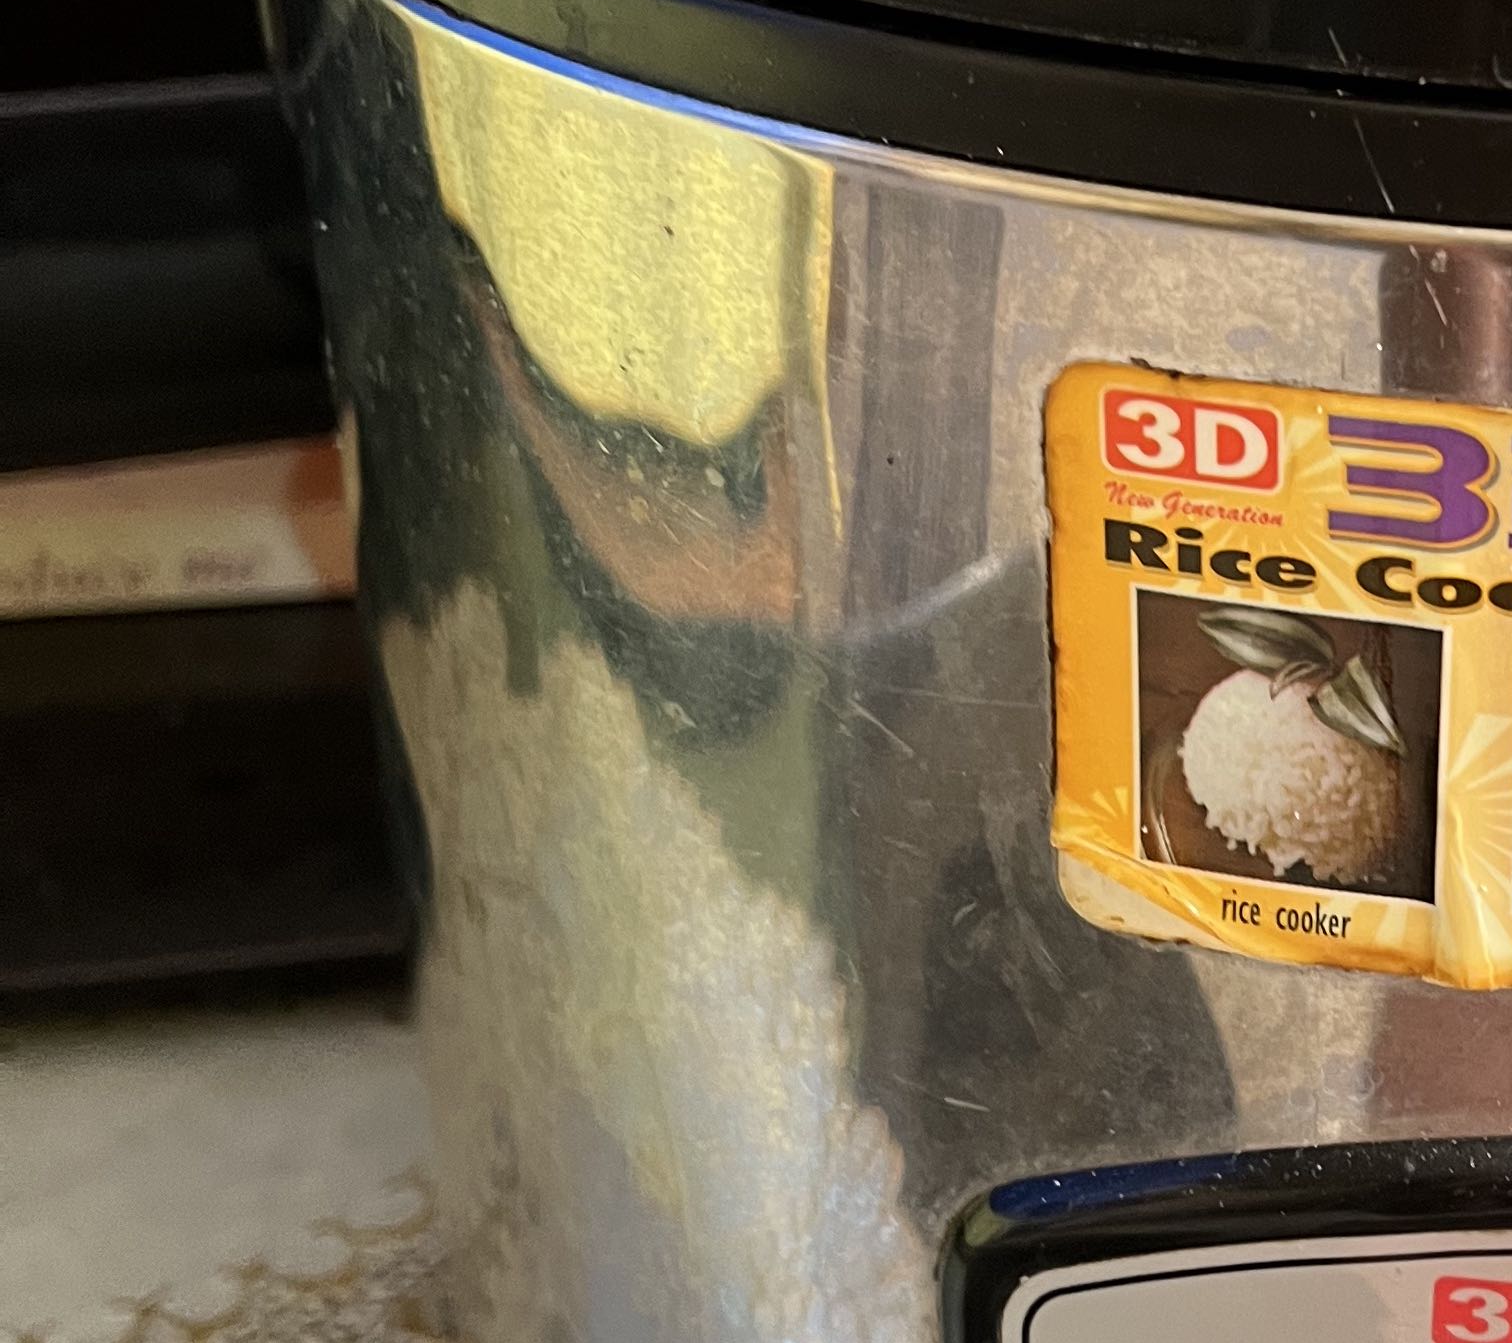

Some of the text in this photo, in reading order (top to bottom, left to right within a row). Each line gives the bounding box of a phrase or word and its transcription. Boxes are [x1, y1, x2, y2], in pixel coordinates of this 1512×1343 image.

[1115, 399, 1269, 479] 3D
[1104, 481, 1284, 527] New Generation
[1103, 518, 1317, 592] Rice
[1221, 889, 1352, 939] rice cooker
